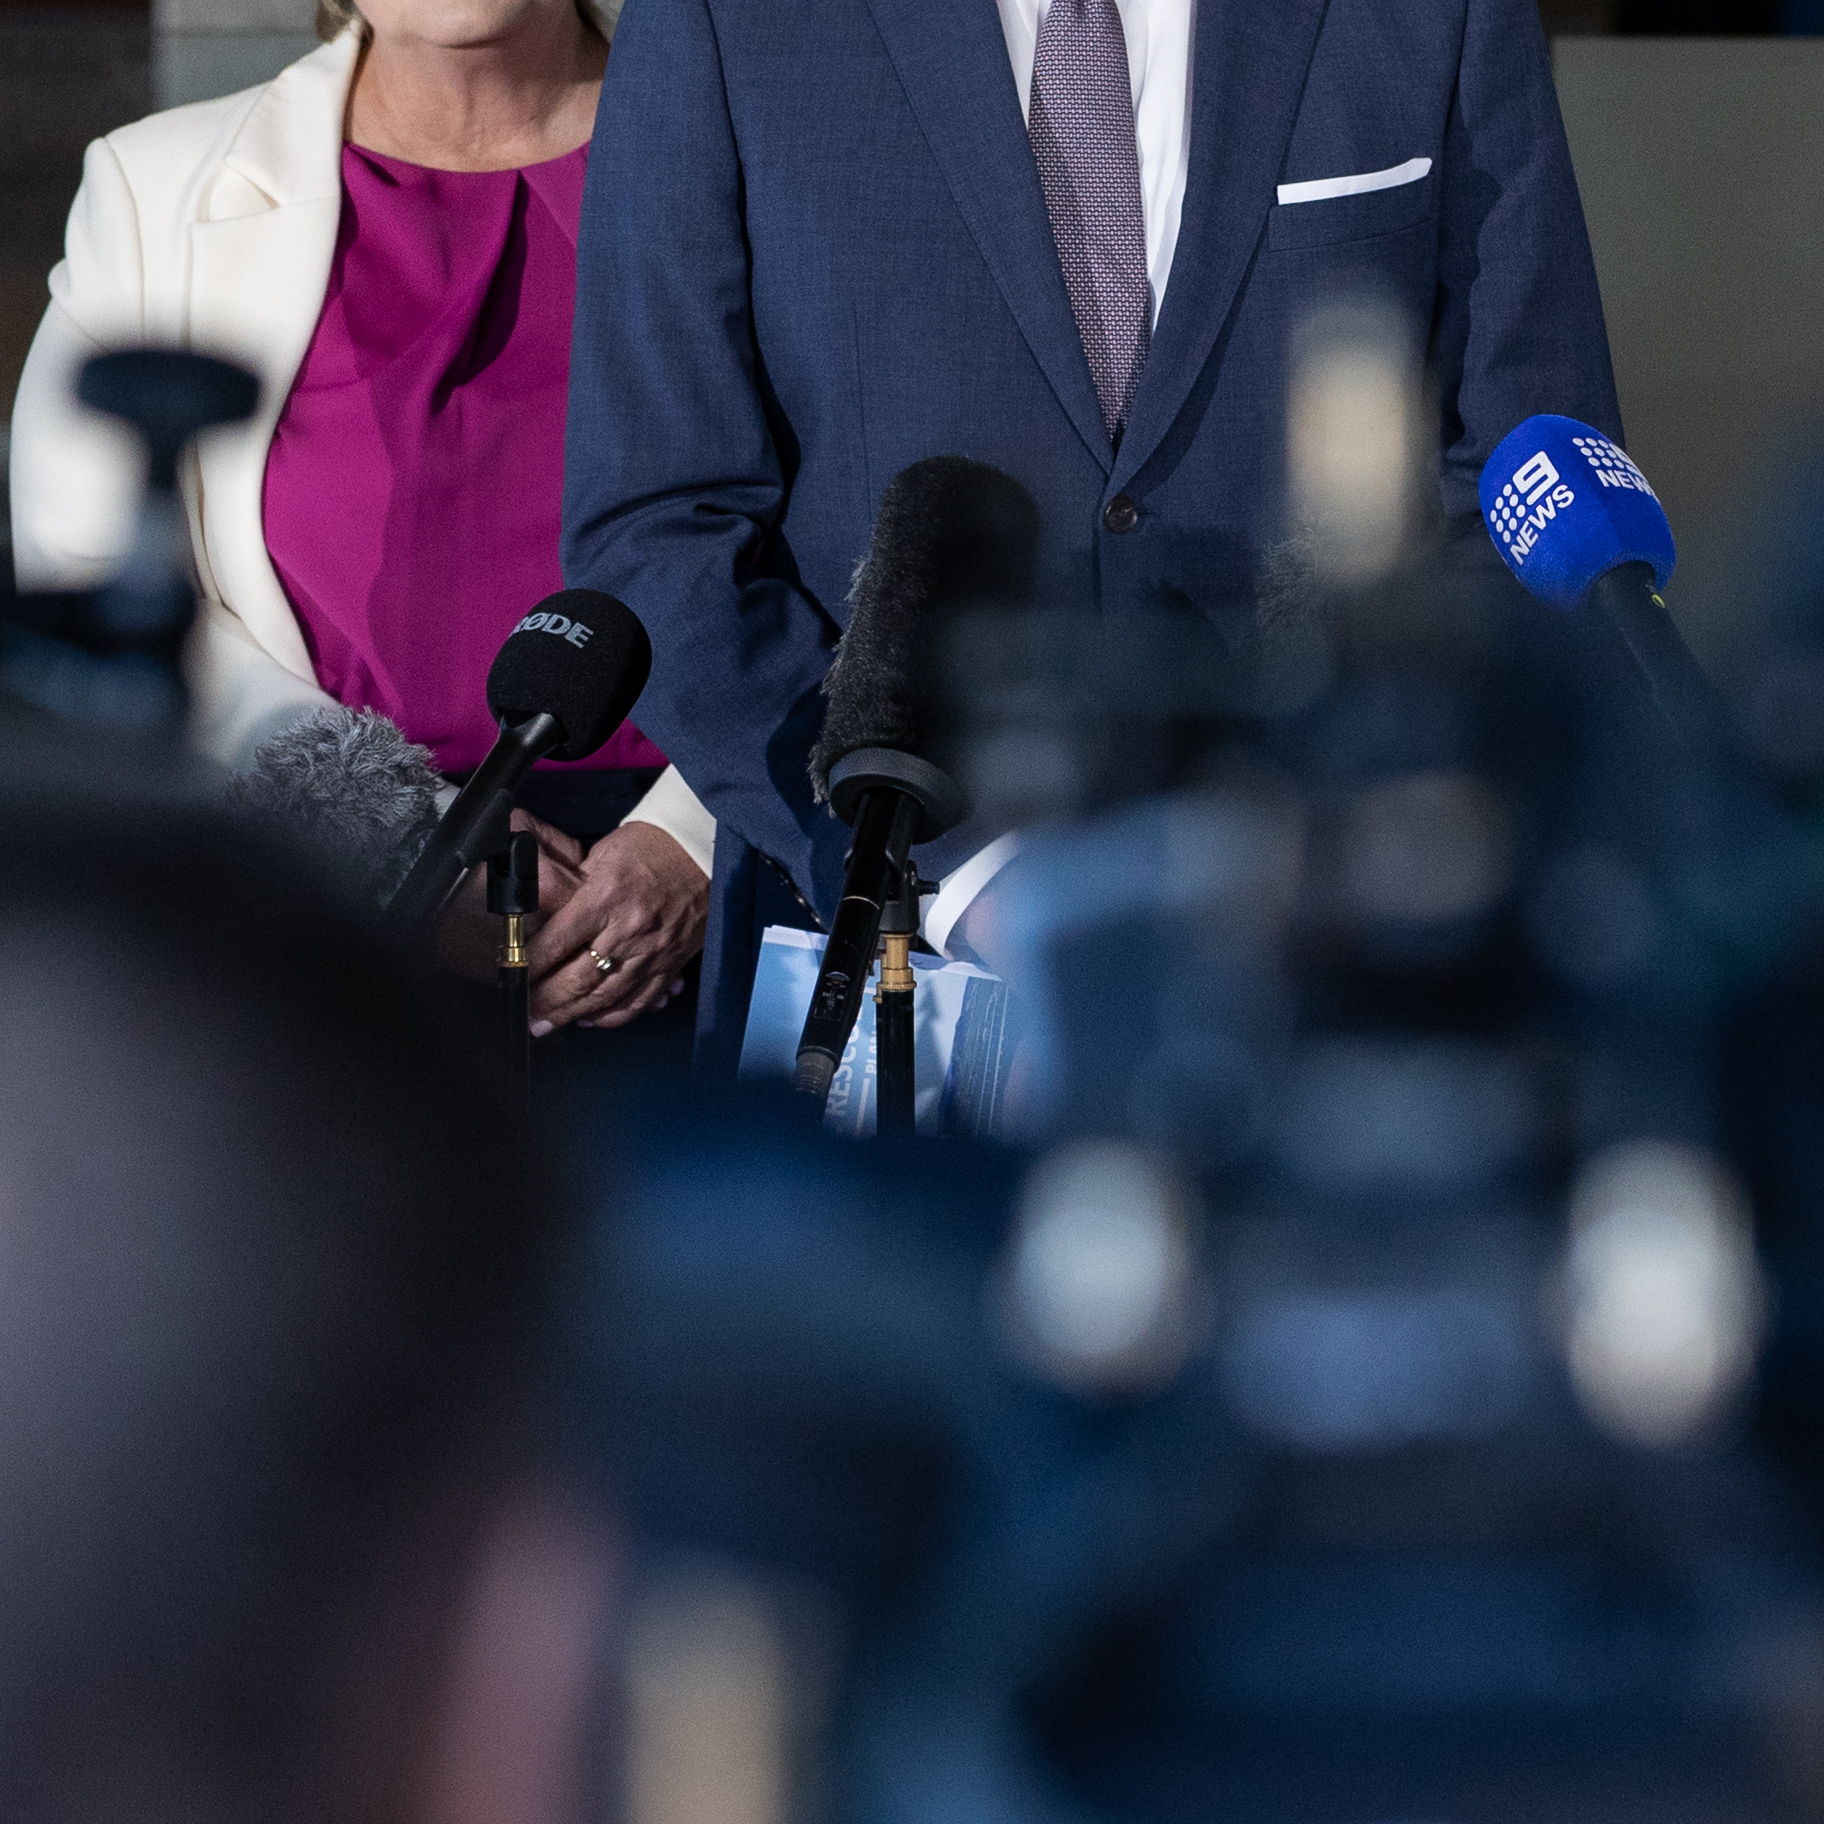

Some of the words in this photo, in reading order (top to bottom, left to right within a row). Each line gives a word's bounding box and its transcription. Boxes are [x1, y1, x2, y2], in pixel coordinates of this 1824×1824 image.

[1512, 451, 1560, 506] 9
[1595, 469, 1657, 501] NEW
[1510, 484, 1575, 566] NEWS
[825, 1007, 863, 1116] RESC
